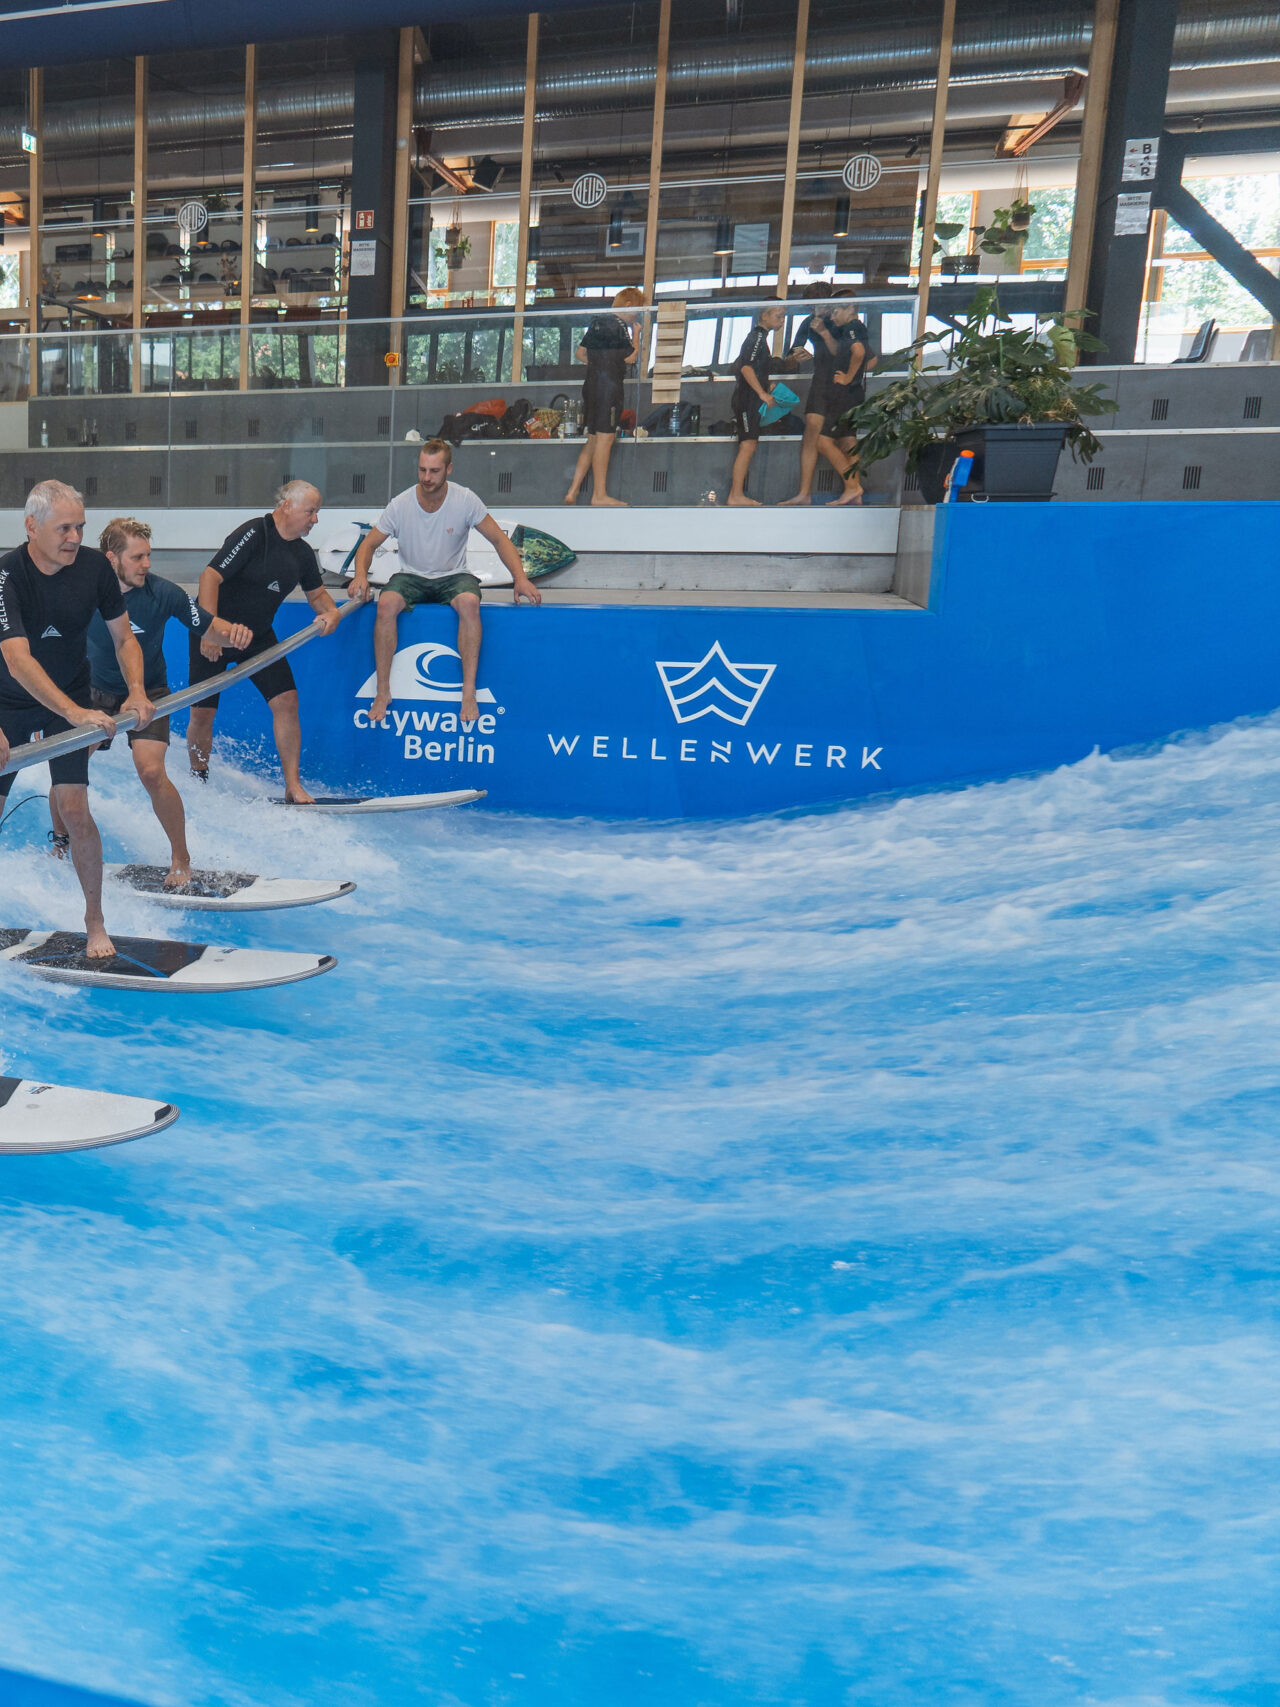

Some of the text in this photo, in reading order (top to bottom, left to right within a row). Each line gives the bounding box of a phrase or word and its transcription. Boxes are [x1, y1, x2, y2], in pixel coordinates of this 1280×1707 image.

[847, 158, 878, 187] DEUS
[574, 176, 604, 203] DEUS
[181, 205, 205, 231] DEUS
[219, 528, 256, 569] WELLENWERK
[404, 735, 494, 763] Berlin
[548, 734, 883, 770] WELLENWERK
